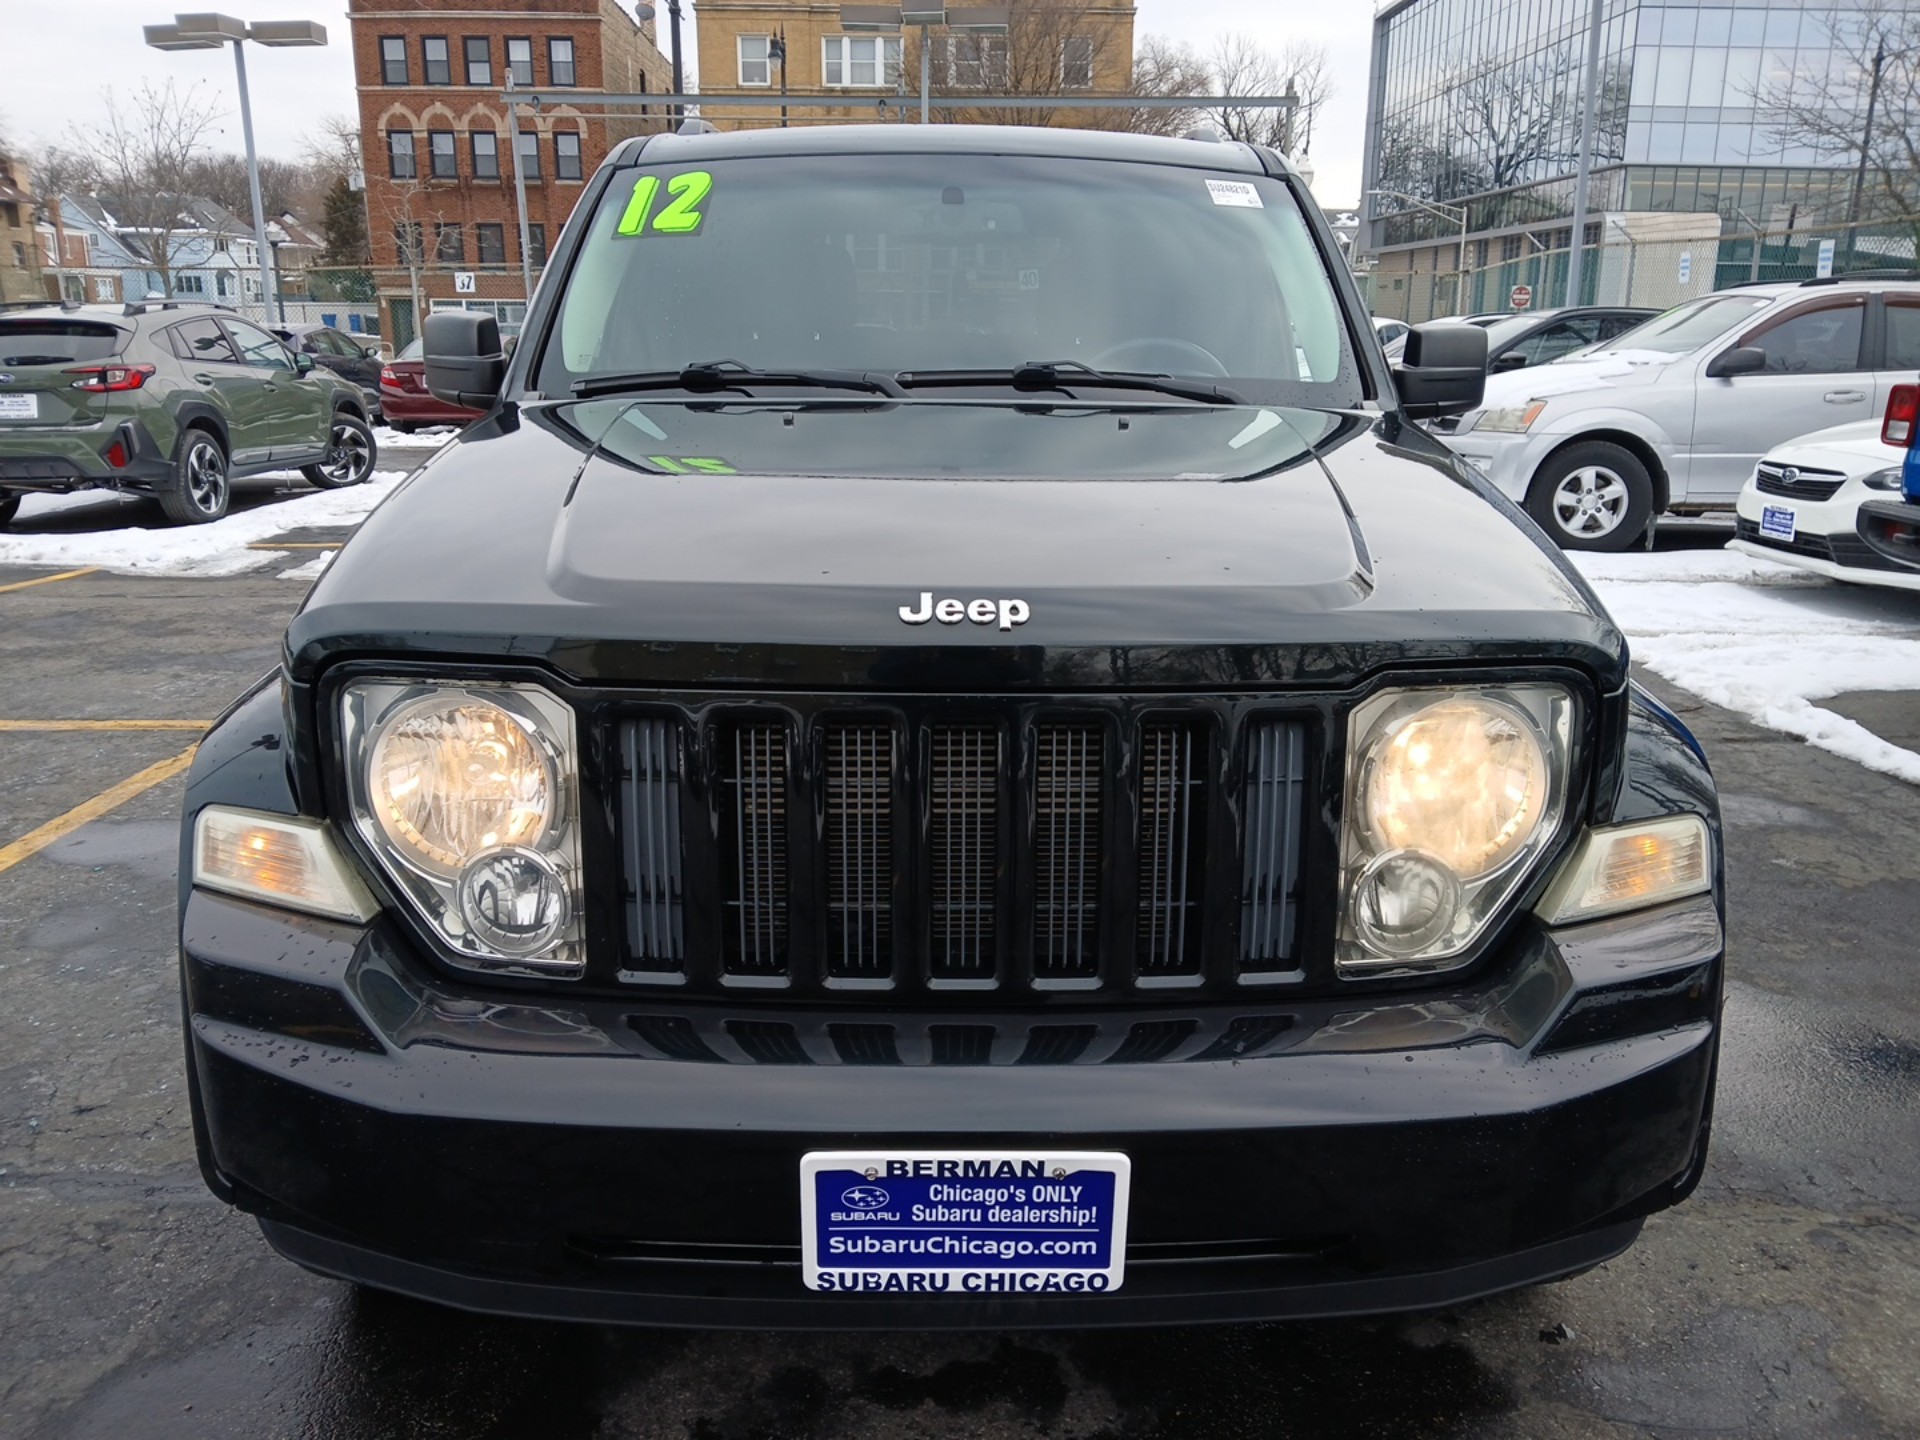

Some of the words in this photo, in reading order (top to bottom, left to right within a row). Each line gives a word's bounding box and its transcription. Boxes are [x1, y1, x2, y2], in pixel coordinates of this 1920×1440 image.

[617, 171, 713, 236] 12
[899, 592, 1030, 631] Jeep
[886, 1160, 1045, 1178] BERMAN
[929, 1183, 1026, 1206] Chicago's
[1032, 1185, 1082, 1203] ONLY
[830, 1211, 900, 1221] SUBARU
[911, 1204, 982, 1222] Subaru
[988, 1206, 1097, 1226] dealership!
[829, 1236, 1097, 1259] SubaruChicago.com
[816, 1272, 949, 1292] SUBARU
[961, 1272, 1110, 1292] CHICAGO
